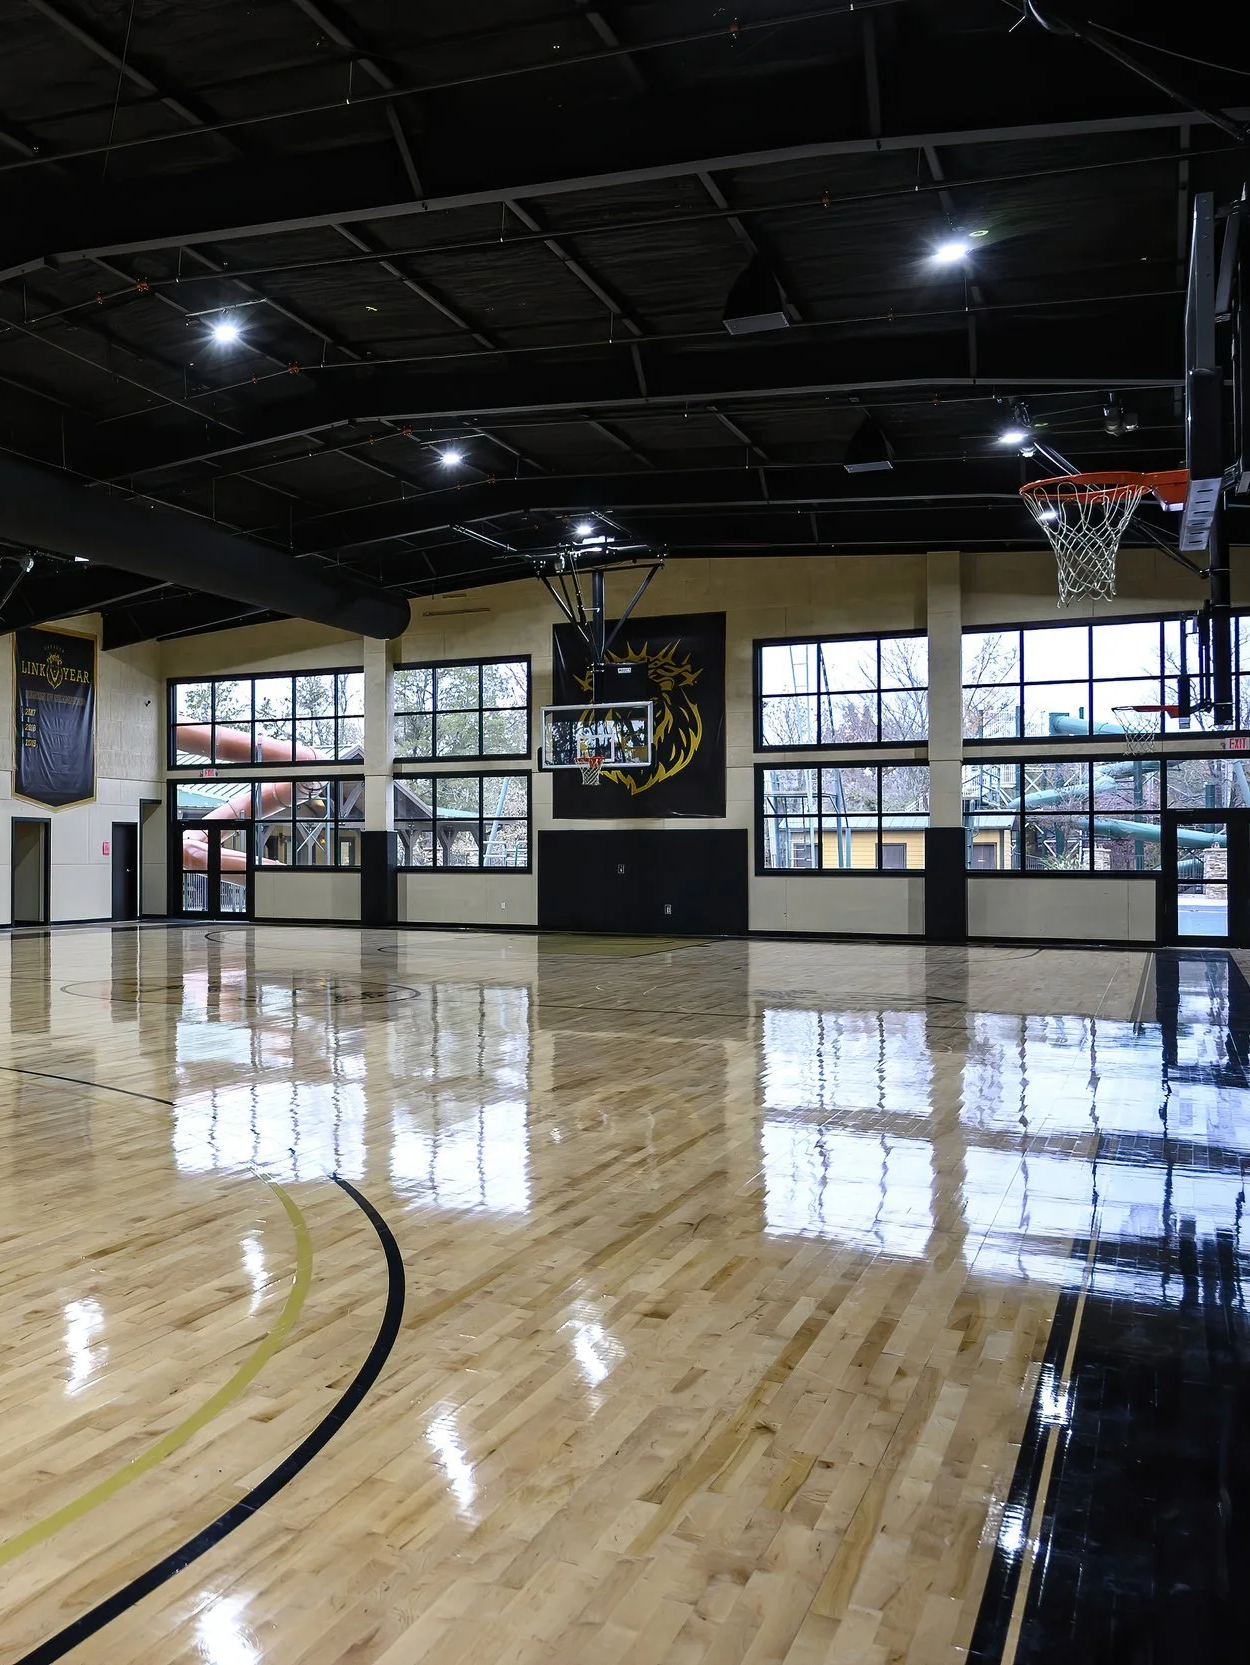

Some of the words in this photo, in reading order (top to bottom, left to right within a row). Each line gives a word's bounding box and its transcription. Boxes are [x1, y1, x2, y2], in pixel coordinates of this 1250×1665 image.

[21, 660, 46, 677] LINK
[62, 667, 90, 684] YEAR
[1229, 737, 1247, 749] EXIT
